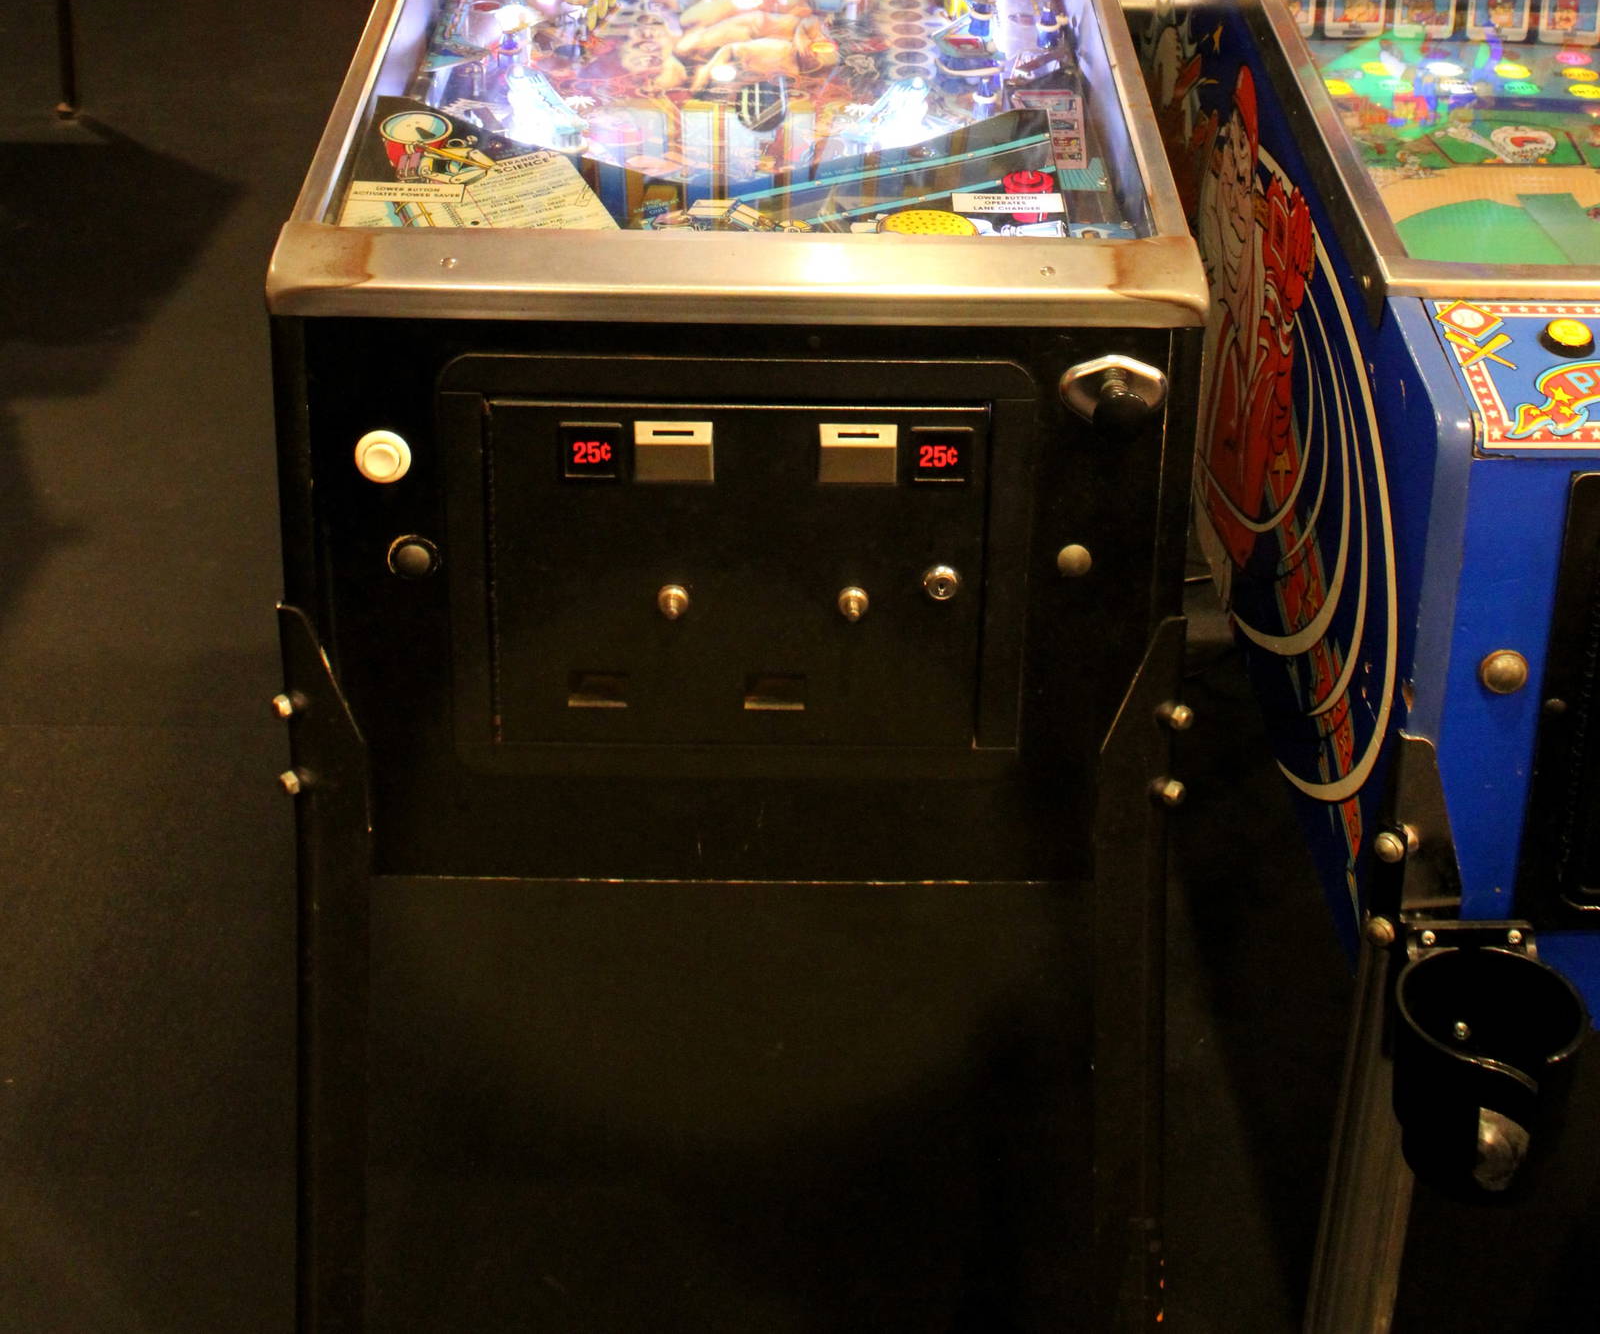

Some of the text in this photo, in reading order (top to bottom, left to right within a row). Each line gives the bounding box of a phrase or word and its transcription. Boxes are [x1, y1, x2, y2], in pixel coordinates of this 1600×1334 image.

[494, 157, 551, 174] SCIENCE
[1564, 370, 1600, 394] P
[572, 440, 613, 465] 25¢
[919, 444, 959, 468] 25¢
